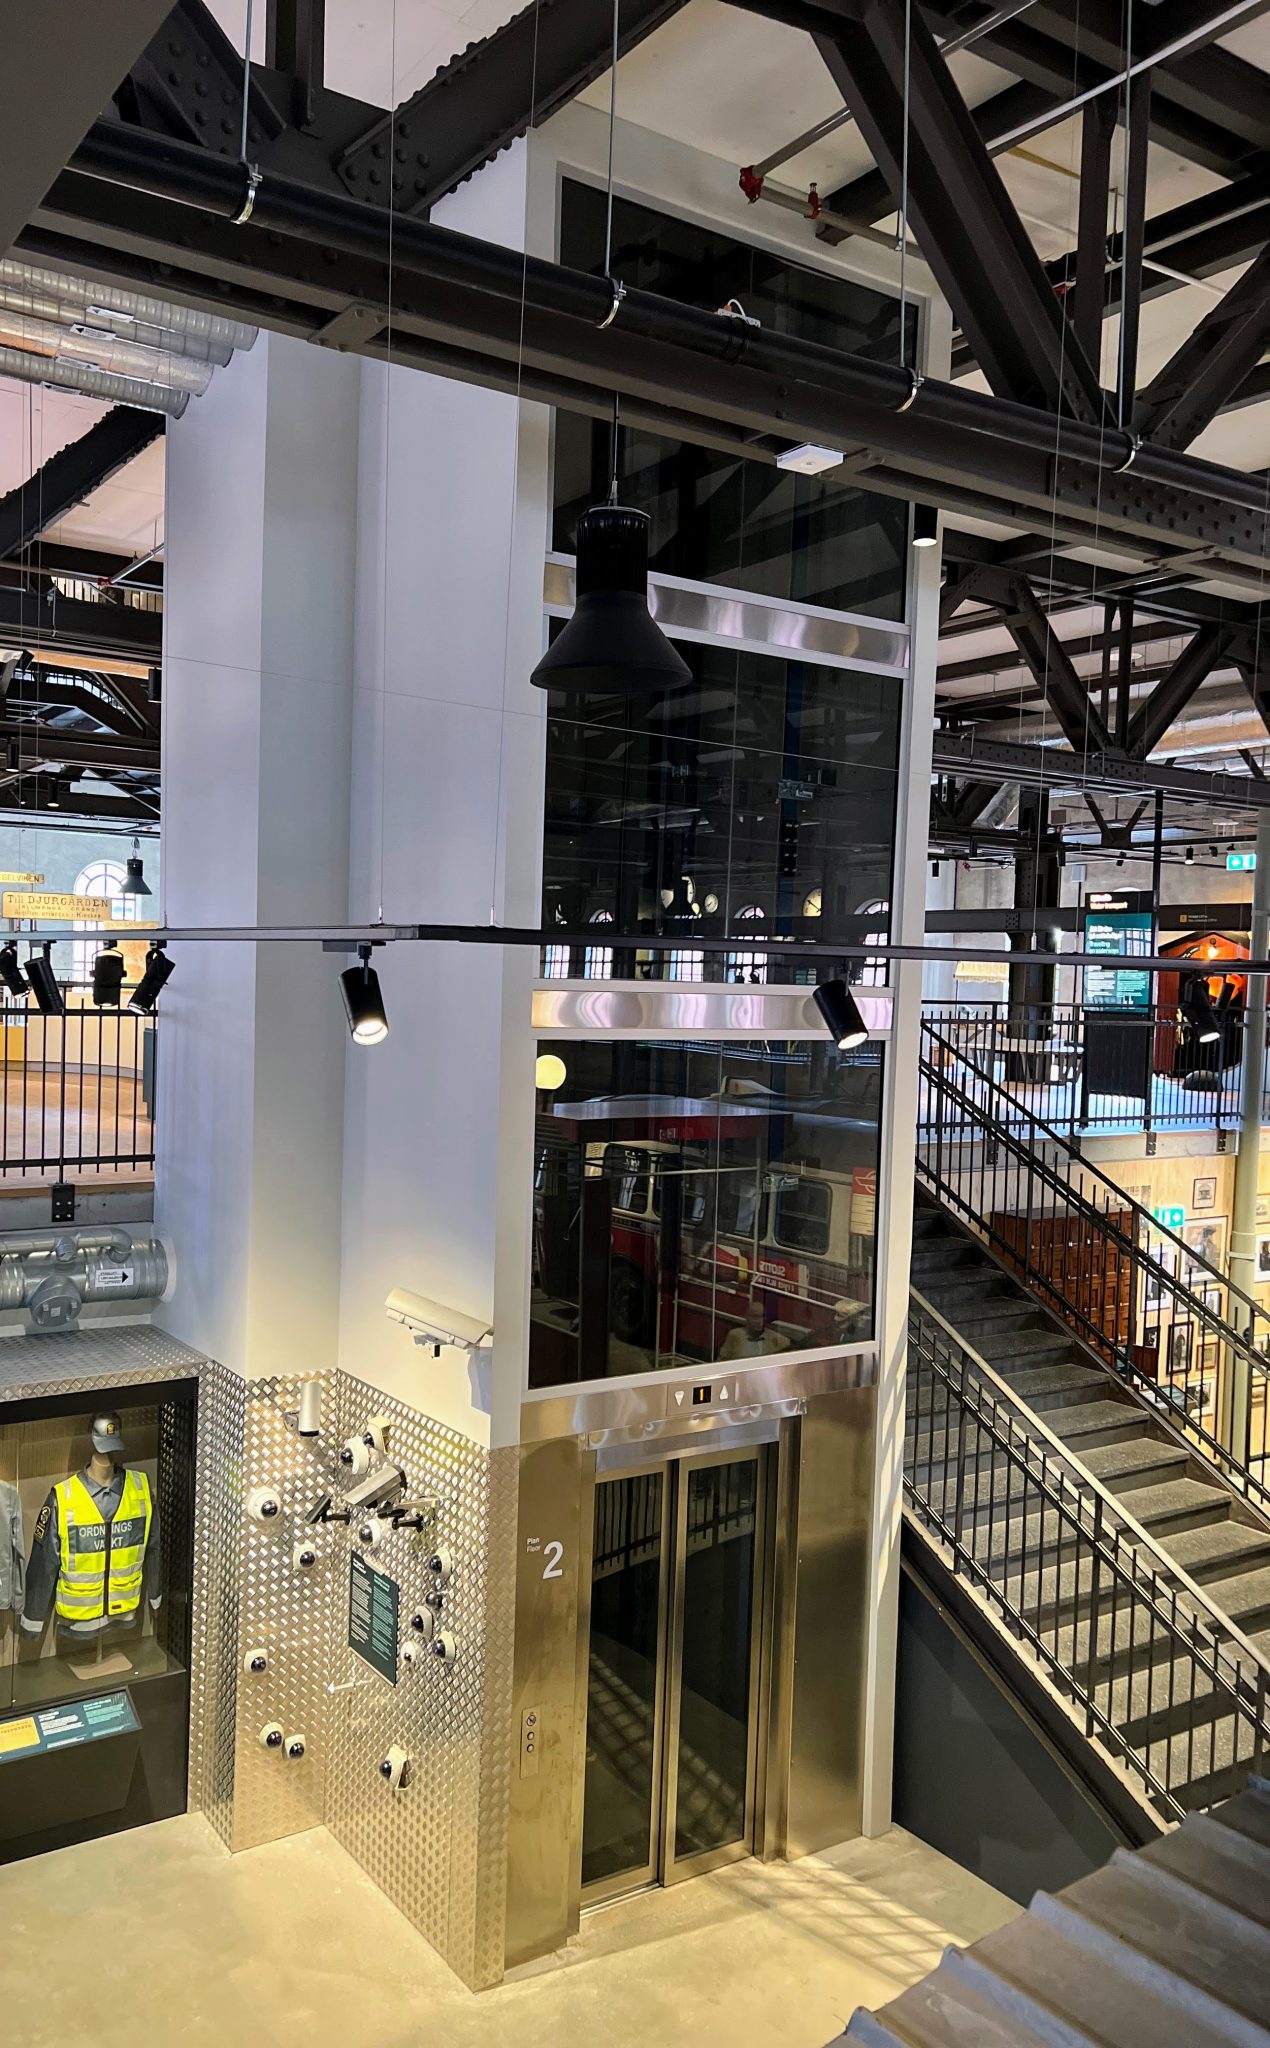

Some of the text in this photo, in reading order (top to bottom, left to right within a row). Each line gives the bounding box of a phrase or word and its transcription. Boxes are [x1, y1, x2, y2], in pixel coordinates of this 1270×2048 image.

[27, 895, 109, 908] DJURGÅRDEN
[699, 1387, 705, 1401] 1
[542, 1540, 564, 1580] 2
